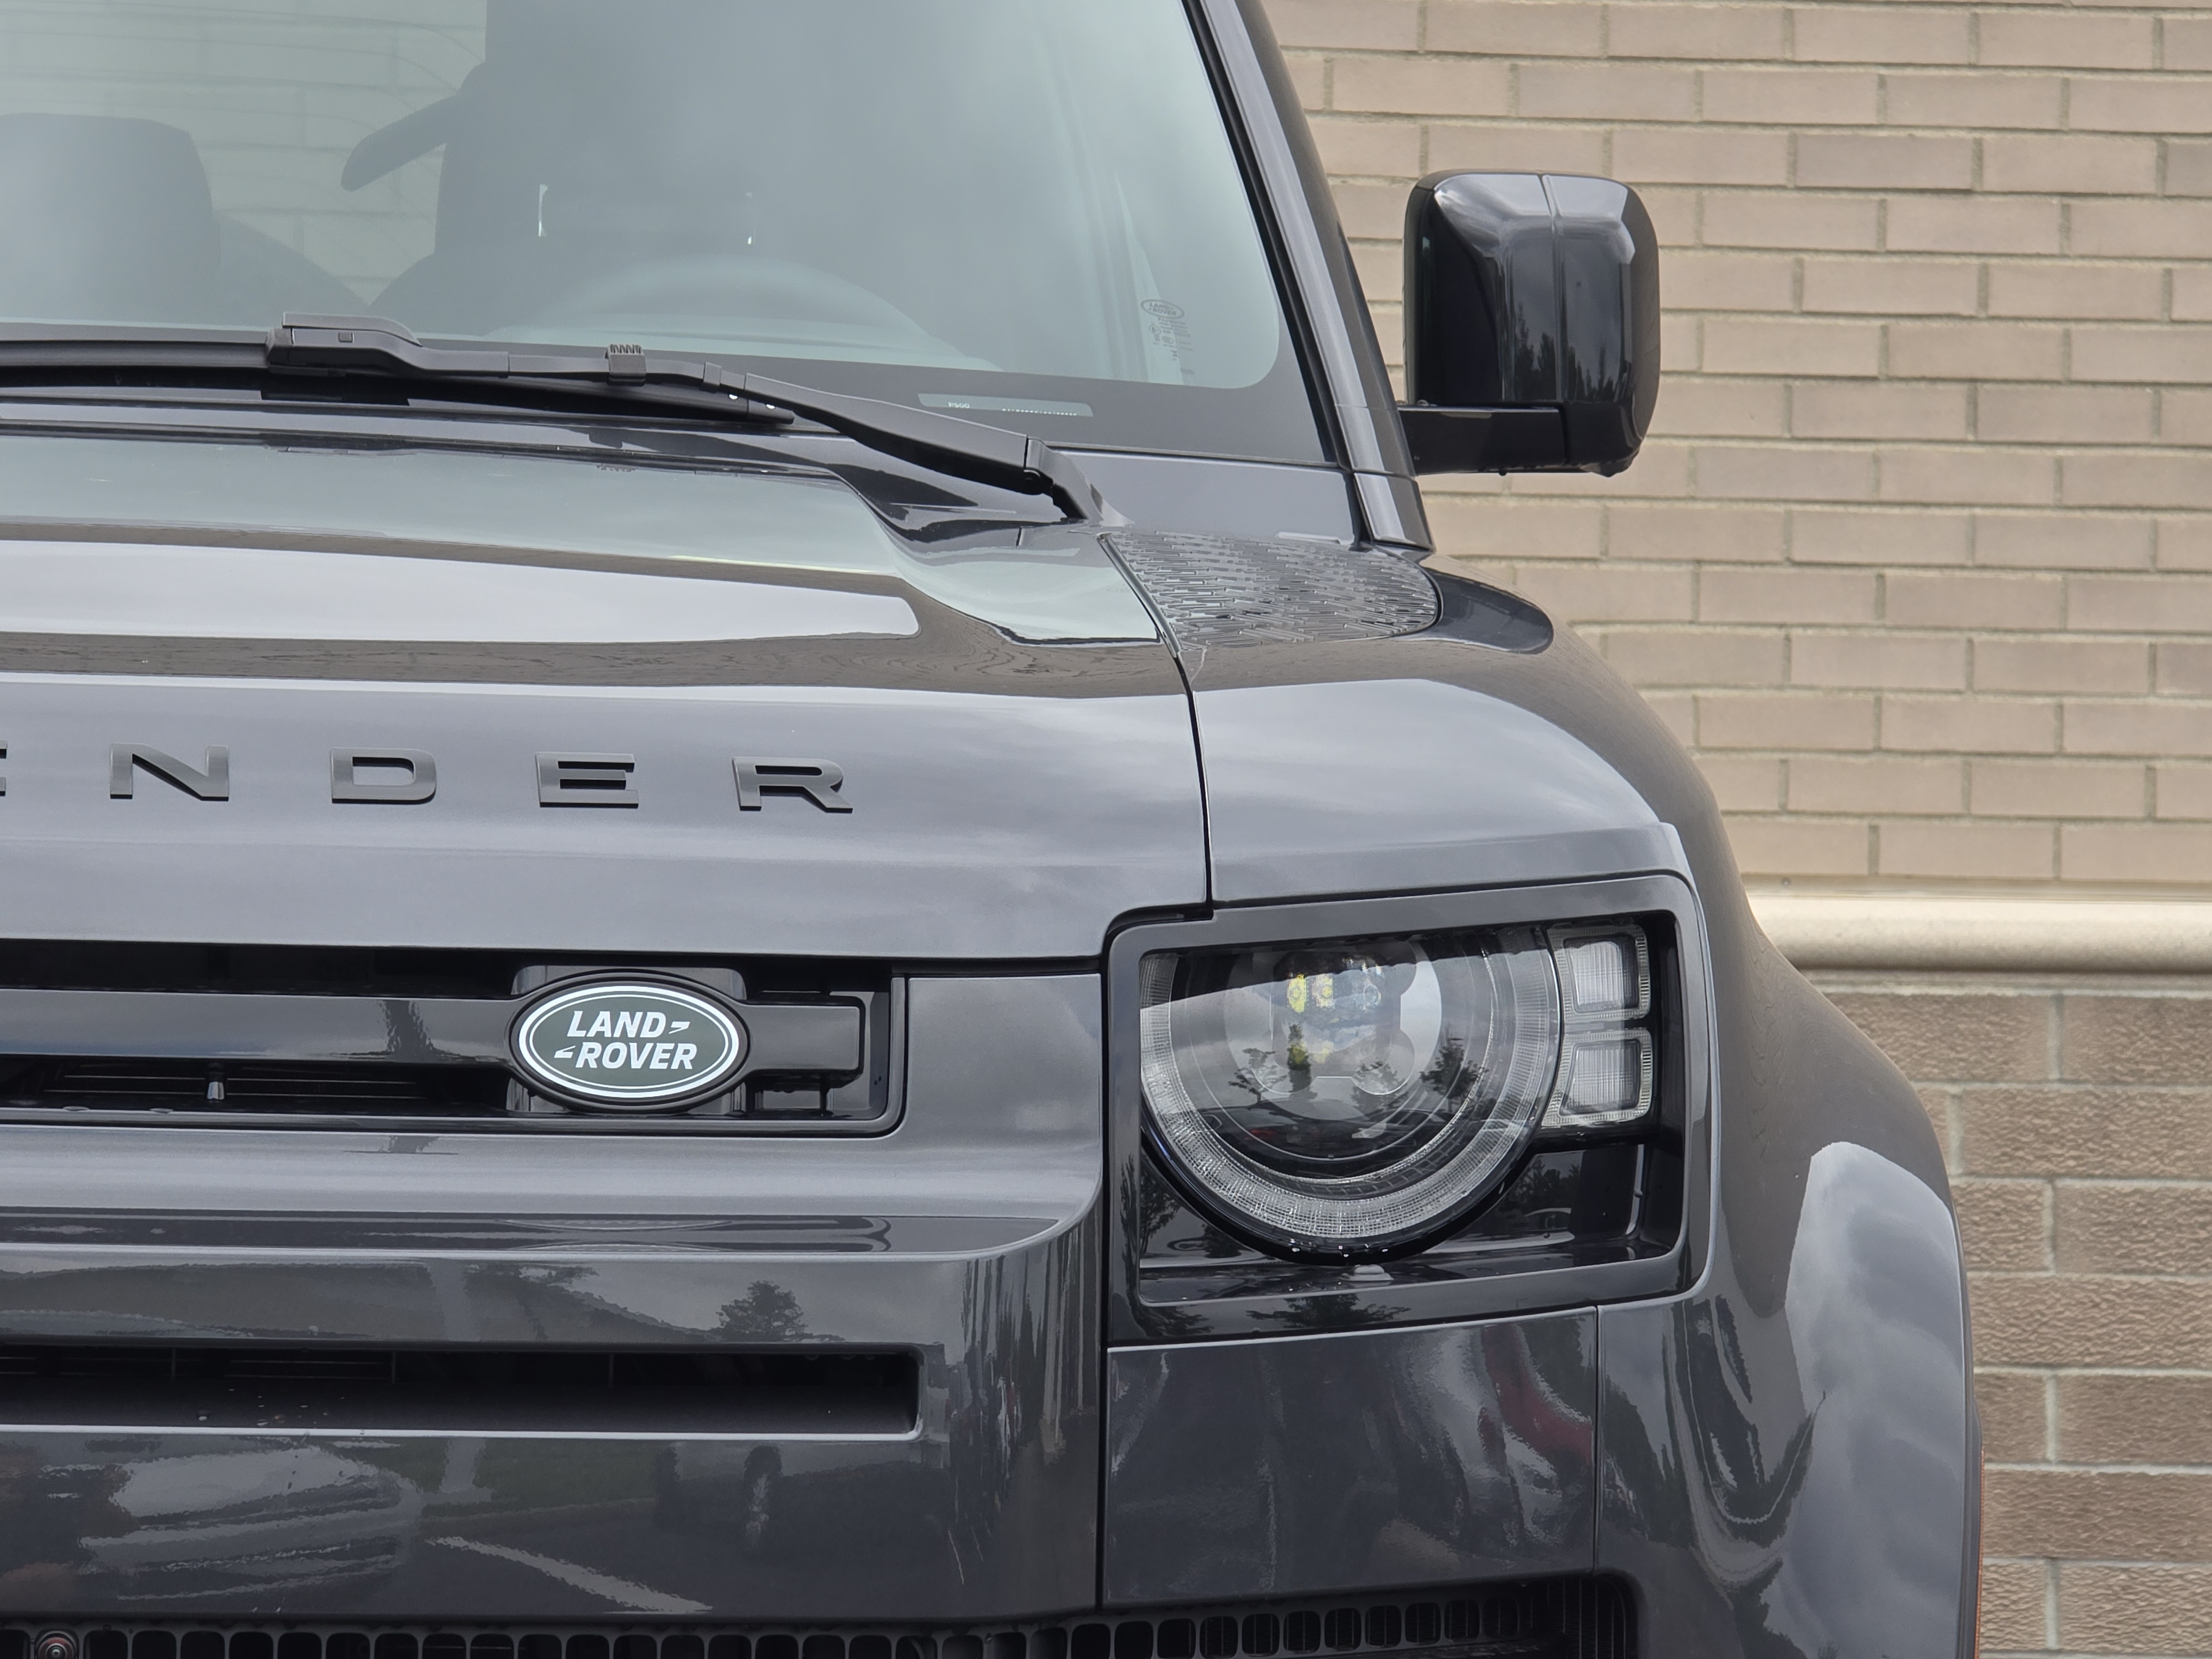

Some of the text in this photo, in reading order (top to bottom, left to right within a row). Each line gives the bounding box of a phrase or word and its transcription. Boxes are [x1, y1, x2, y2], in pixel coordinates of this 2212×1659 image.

[0, 740, 853, 813] NDER
[567, 1011, 666, 1038] LAND
[575, 1042, 697, 1070] ROVER
